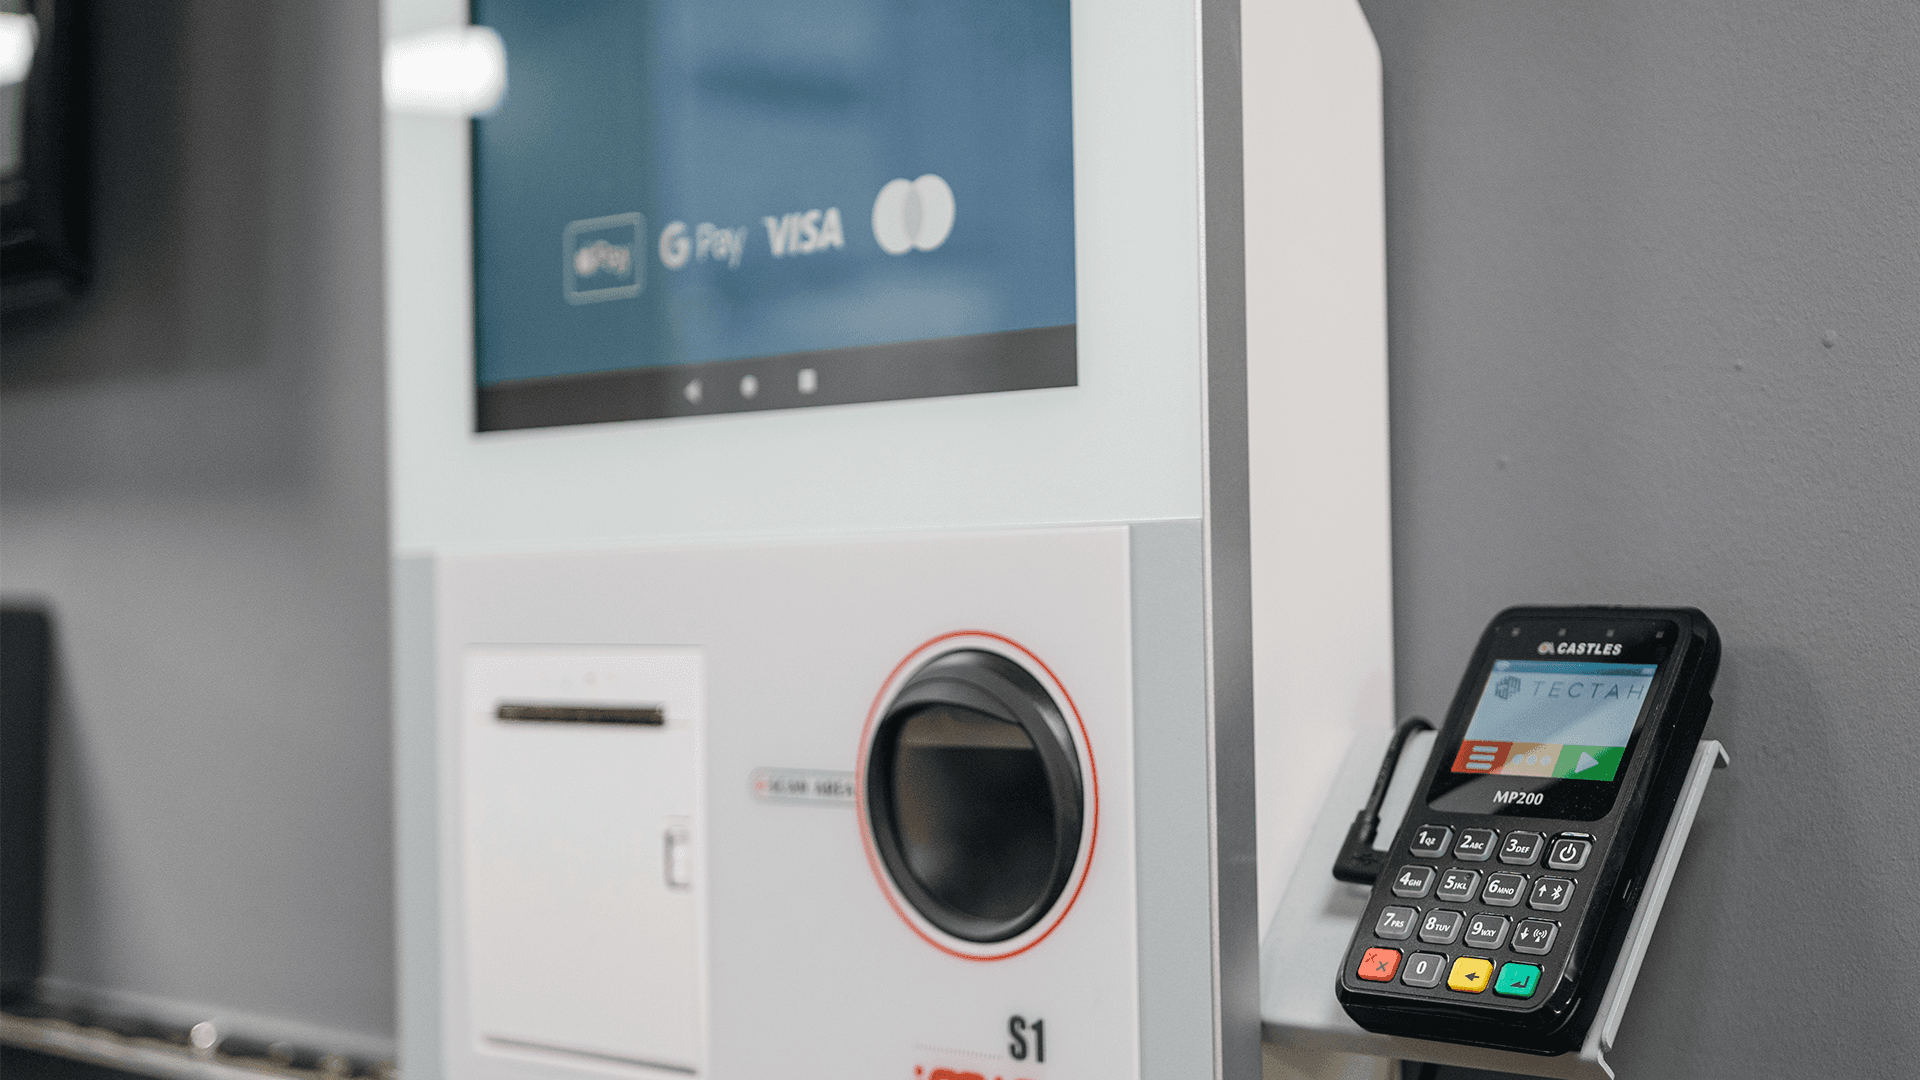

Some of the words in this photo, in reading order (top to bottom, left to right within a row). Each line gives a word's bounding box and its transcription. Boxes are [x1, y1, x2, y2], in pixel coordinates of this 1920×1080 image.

[763, 207, 845, 259] VISA
[659, 220, 691, 270] G
[696, 221, 748, 270] Pay
[1556, 642, 1623, 656] CASTLES
[1532, 680, 1645, 700] TECTAH
[1493, 790, 1545, 806] MP200
[1416, 960, 1428, 975] 0
[1008, 1014, 1045, 1063] S1
